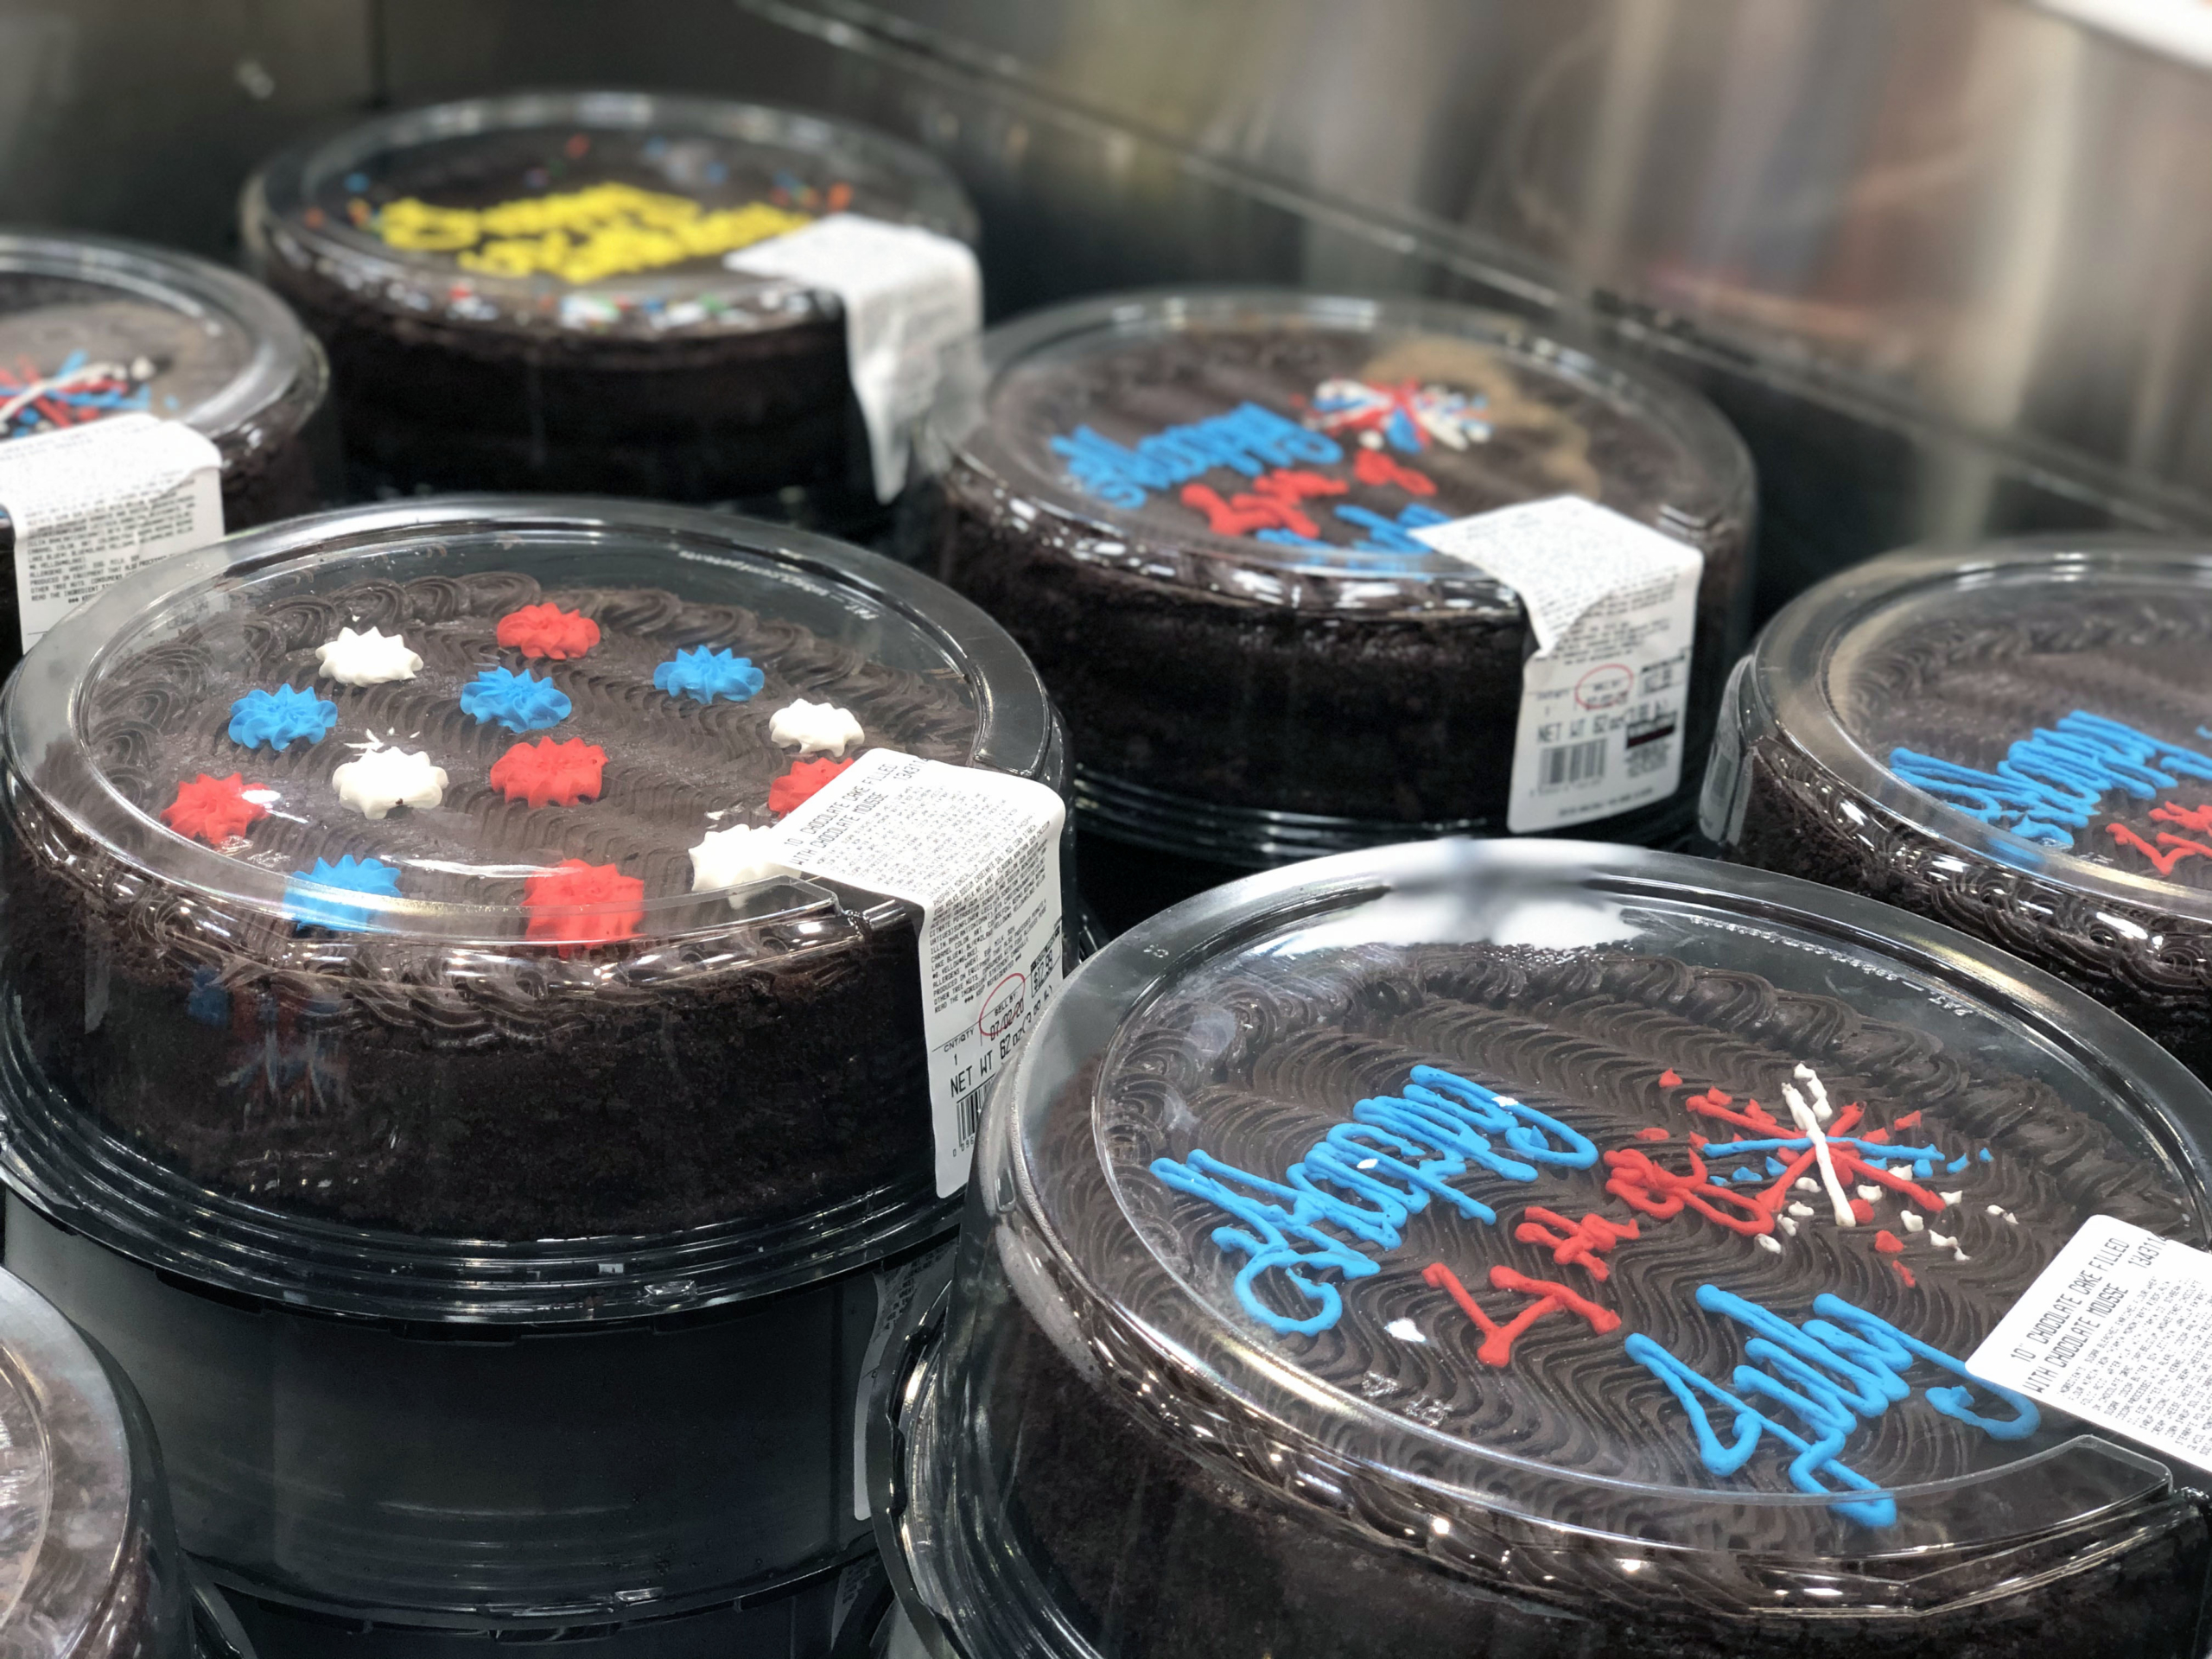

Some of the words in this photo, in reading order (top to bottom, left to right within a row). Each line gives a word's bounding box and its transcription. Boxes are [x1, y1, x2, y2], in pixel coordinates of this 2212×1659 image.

[800, 802, 850, 835] CHOCOLATE
[842, 785, 870, 802] CAKE
[810, 814, 861, 849] CHOCOLATE
[852, 791, 889, 814] MOUSSE
[944, 1027, 975, 1052] CNT/QTY
[950, 1065, 973, 1098] NET
[980, 1049, 993, 1077] WT
[2026, 1294, 2082, 1344] CHOCOLATE
[2069, 1270, 2102, 1295] CAKE
[2088, 1238, 2130, 1271] FILLED
[2023, 1366, 2058, 1394] WITH
[2044, 1317, 2101, 1368] CHOCOLATE
[2086, 1283, 2128, 1318] MOUSSE
